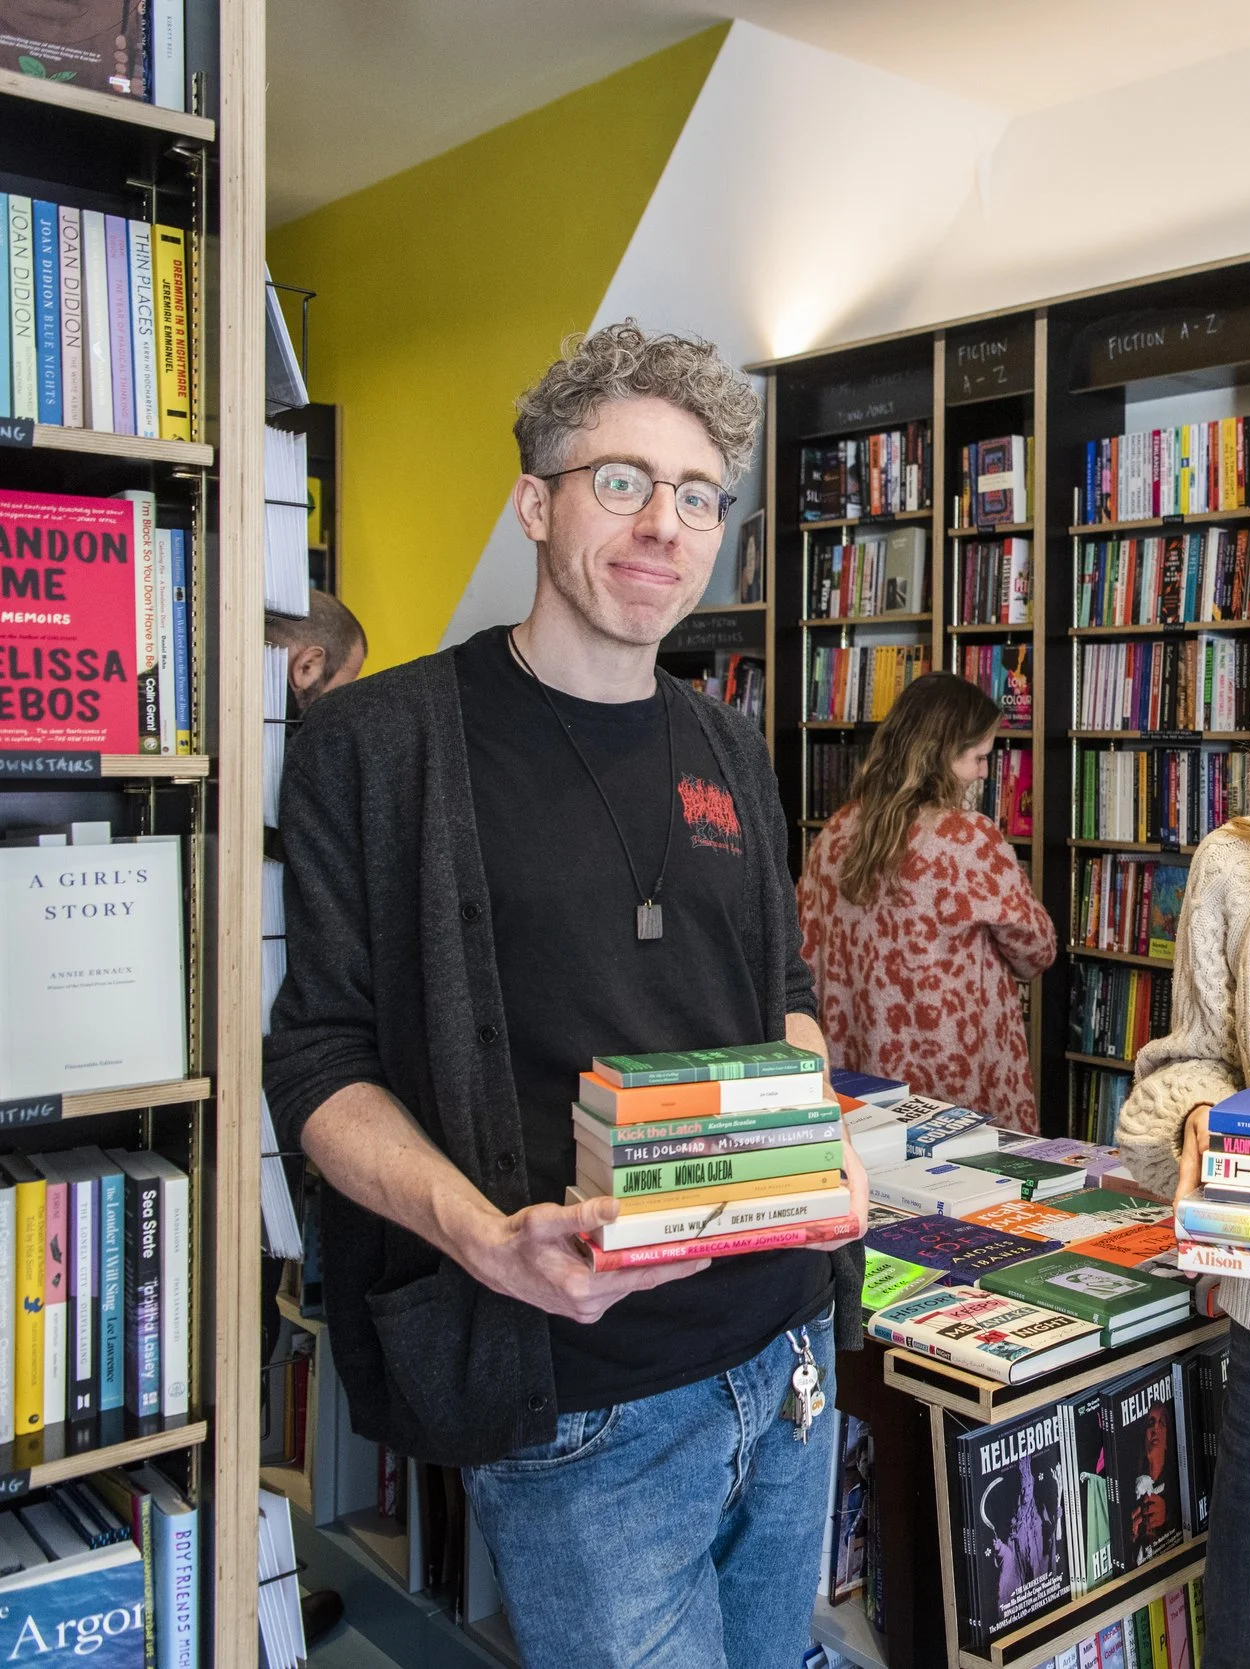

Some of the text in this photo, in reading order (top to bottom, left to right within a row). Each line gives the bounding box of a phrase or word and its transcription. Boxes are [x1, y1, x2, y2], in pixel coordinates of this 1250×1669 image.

[40, 218, 53, 260] JOAN
[12, 204, 32, 339] JOAN DIDION
[62, 214, 82, 349] JOAN DIDION
[136, 234, 152, 335] THIN PLACES
[163, 279, 174, 373] JEREMIAH EMMANUEL
[174, 260, 187, 398] DREAMING NIGHTMARE
[957, 337, 1008, 366] FICTION
[1108, 331, 1164, 360] FICTION
[2, 568, 66, 601] ME
[1, 613, 71, 625] MEMOIRS
[29, 869, 148, 889] A GIRL'S
[44, 901, 135, 920] STORY
[50, 967, 133, 980] ANNIE ERNAUX
[617, 1122, 702, 1141] Kick the Latch
[917, 1115, 955, 1130] THE
[917, 1112, 984, 1143] COLONY
[625, 1142, 705, 1160] THE DOLORIAD
[718, 1129, 814, 1149] MISSOURI WILLIAMS
[623, 1160, 733, 1193] JAWBONE MÓNICA OJEDA
[143, 1190, 157, 1258] Sea State
[731, 1206, 808, 1225] DEATH BY LANDSCAPE
[664, 1223, 685, 1235] ELVIA
[630, 1231, 799, 1263] SMALL FIRES REBECCA MAY JOHNSON
[952, 1240, 1015, 1264] ANDRÉS
[1192, 1246, 1243, 1270] Alison
[889, 1293, 956, 1320] HISTORY
[950, 1300, 998, 1318] KEEPS
[980, 1307, 1039, 1328] AWAKE
[944, 1323, 971, 1339] ME
[1018, 1316, 1070, 1338] NIGHT
[175, 1530, 192, 1633] BOYFRIENDS
